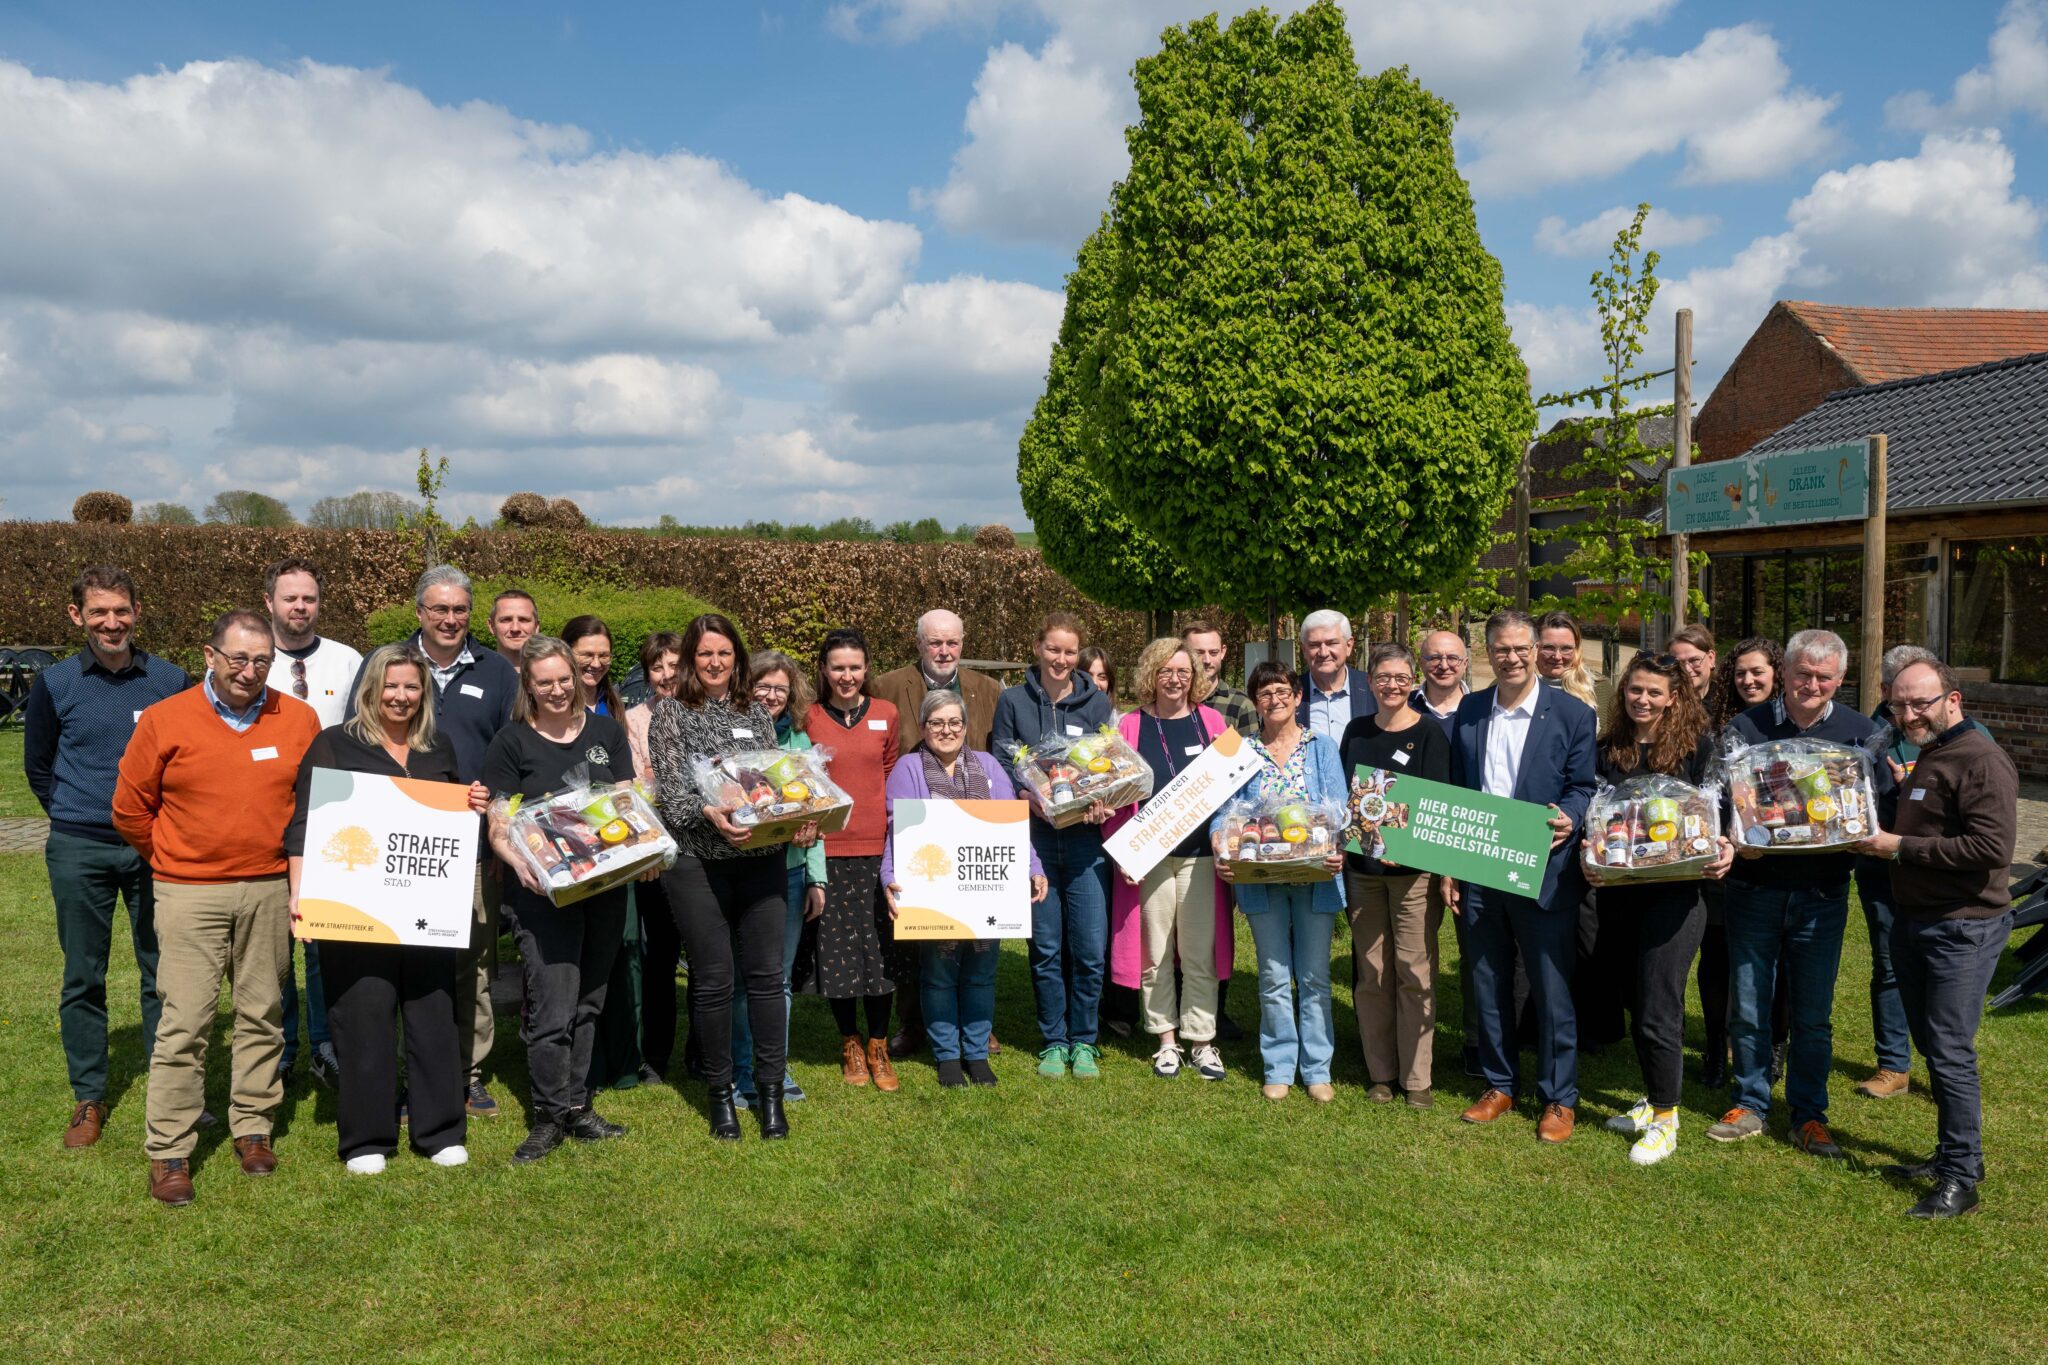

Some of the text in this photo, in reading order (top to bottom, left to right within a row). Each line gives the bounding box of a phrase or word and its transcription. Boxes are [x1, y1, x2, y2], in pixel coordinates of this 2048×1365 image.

[1788, 475, 1826, 492] DRANK
[1685, 509, 1731, 525] EN DRANKJE
[1783, 501, 1792, 511] OF
[1128, 770, 1216, 853] STRAFFE STREEK
[1133, 774, 1189, 824] Wij zijn een
[1158, 798, 1214, 849] GEMEENTE
[1418, 797, 1498, 827] HIER GROEIT
[1415, 811, 1501, 843] ONZE LOKALE
[387, 832, 461, 858] STRAFFE
[957, 845, 1016, 863] STRAFFE
[1412, 825, 1539, 868] VOEDSELSTRATEGIE
[385, 854, 449, 879] STREEK
[957, 864, 1009, 881] STREEK
[383, 877, 412, 888] STAD
[309, 921, 375, 932] WWW.STRAFFESTREEK.BE
